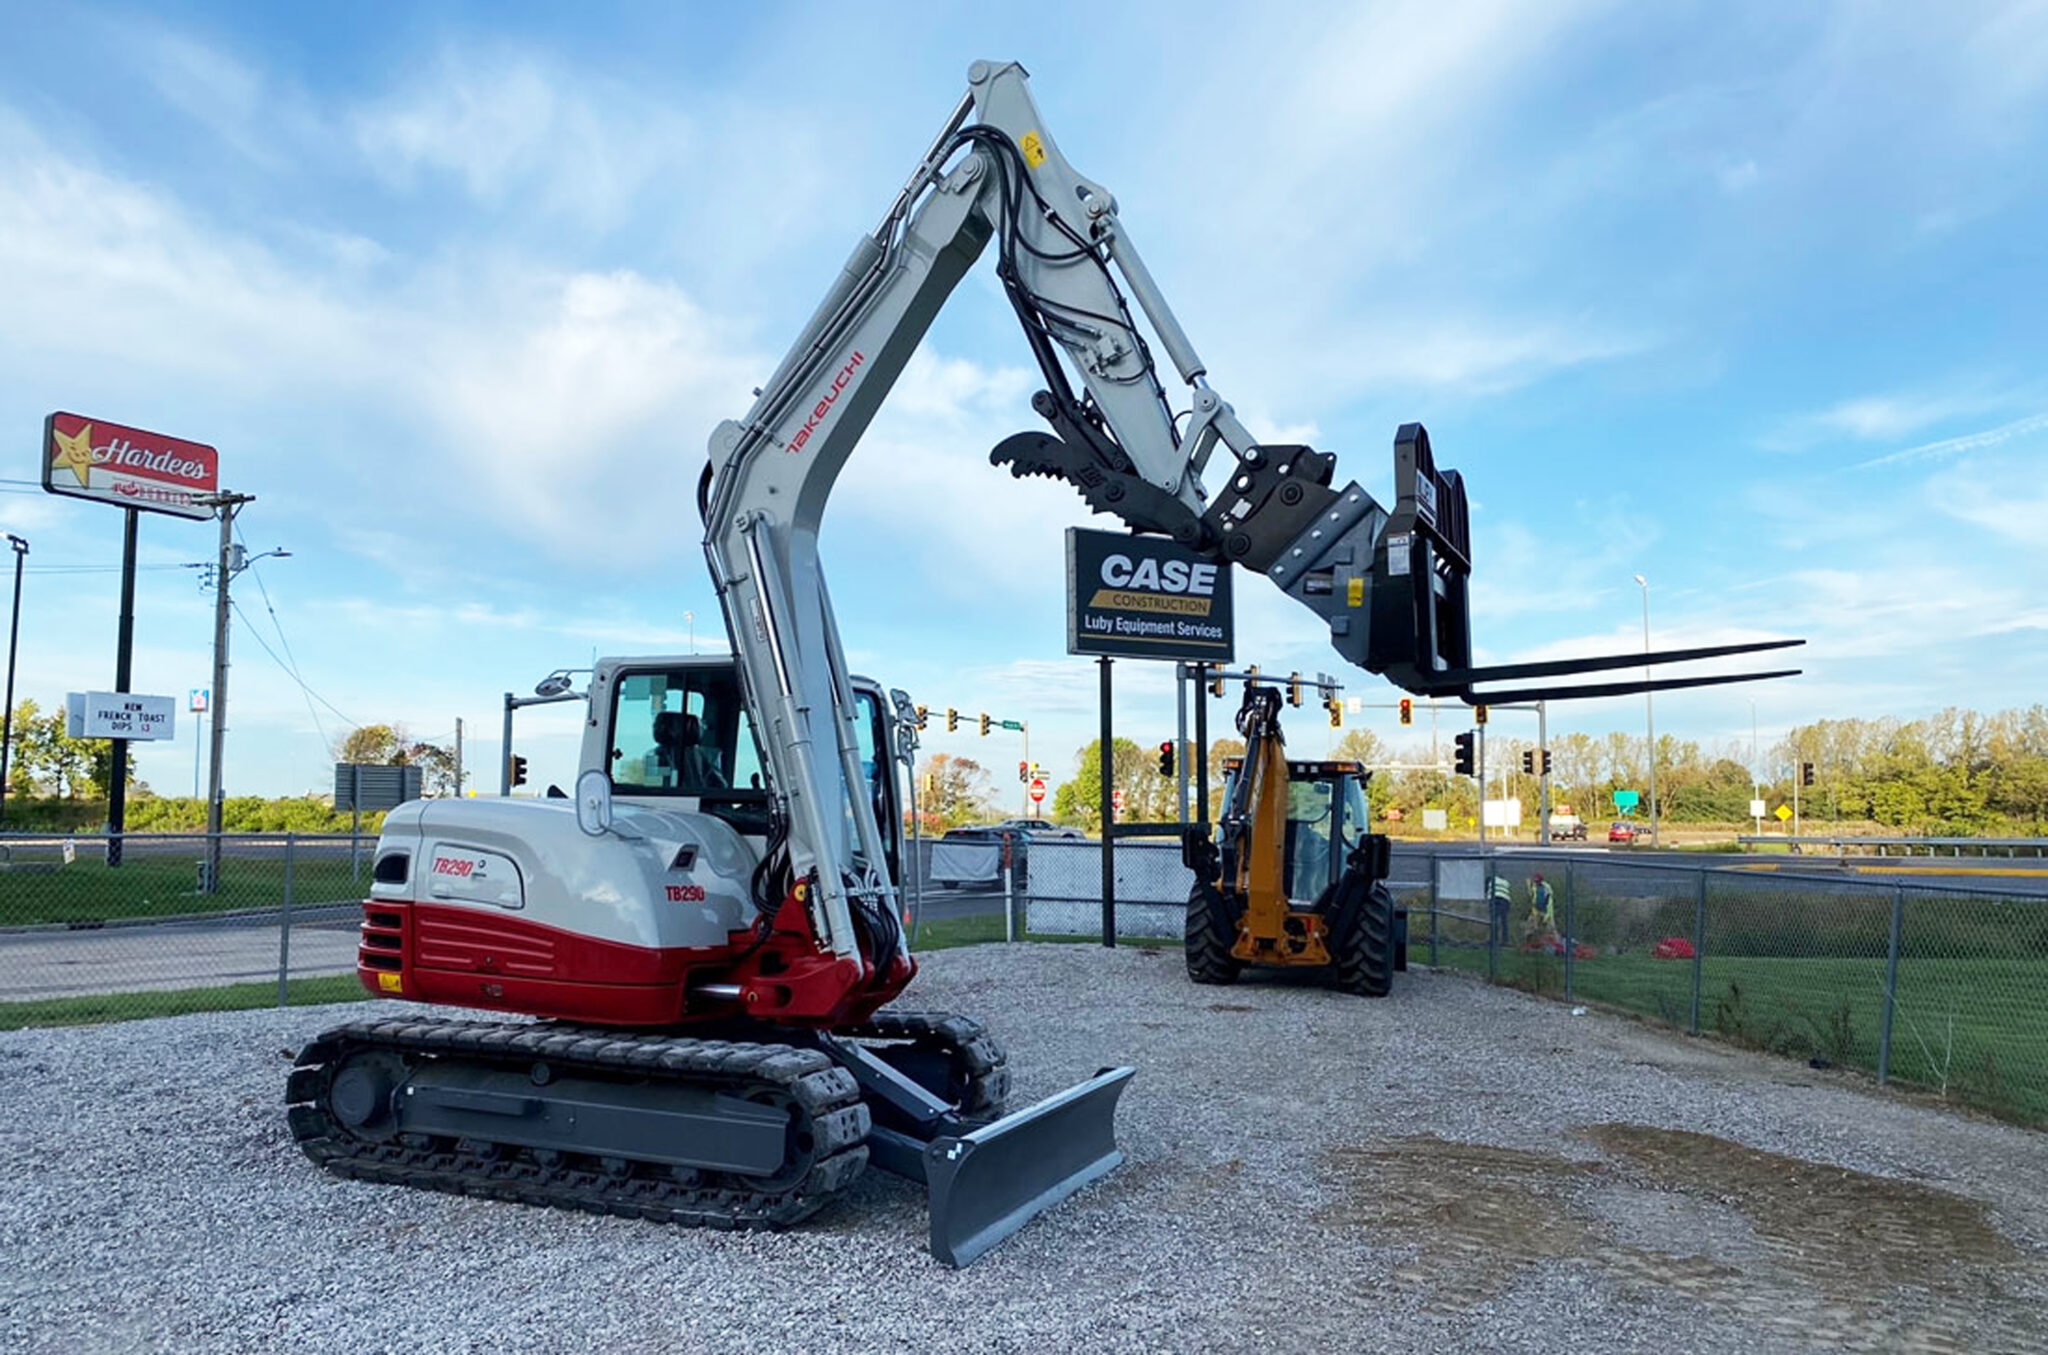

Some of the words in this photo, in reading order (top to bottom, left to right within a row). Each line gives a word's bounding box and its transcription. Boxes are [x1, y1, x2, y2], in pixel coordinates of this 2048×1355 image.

[1101, 554, 1218, 595] CASE
[1113, 593, 1208, 613] CONSTRUCTION
[1085, 614, 1113, 633] Luby
[1116, 617, 1175, 635] Equipment
[1177, 621, 1222, 639] Services
[98, 710, 131, 720] FRENCH
[138, 713, 165, 722] TOAST
[124, 703, 143, 711] NEW
[433, 858, 473, 877] TB290
[665, 885, 705, 902] TB290
